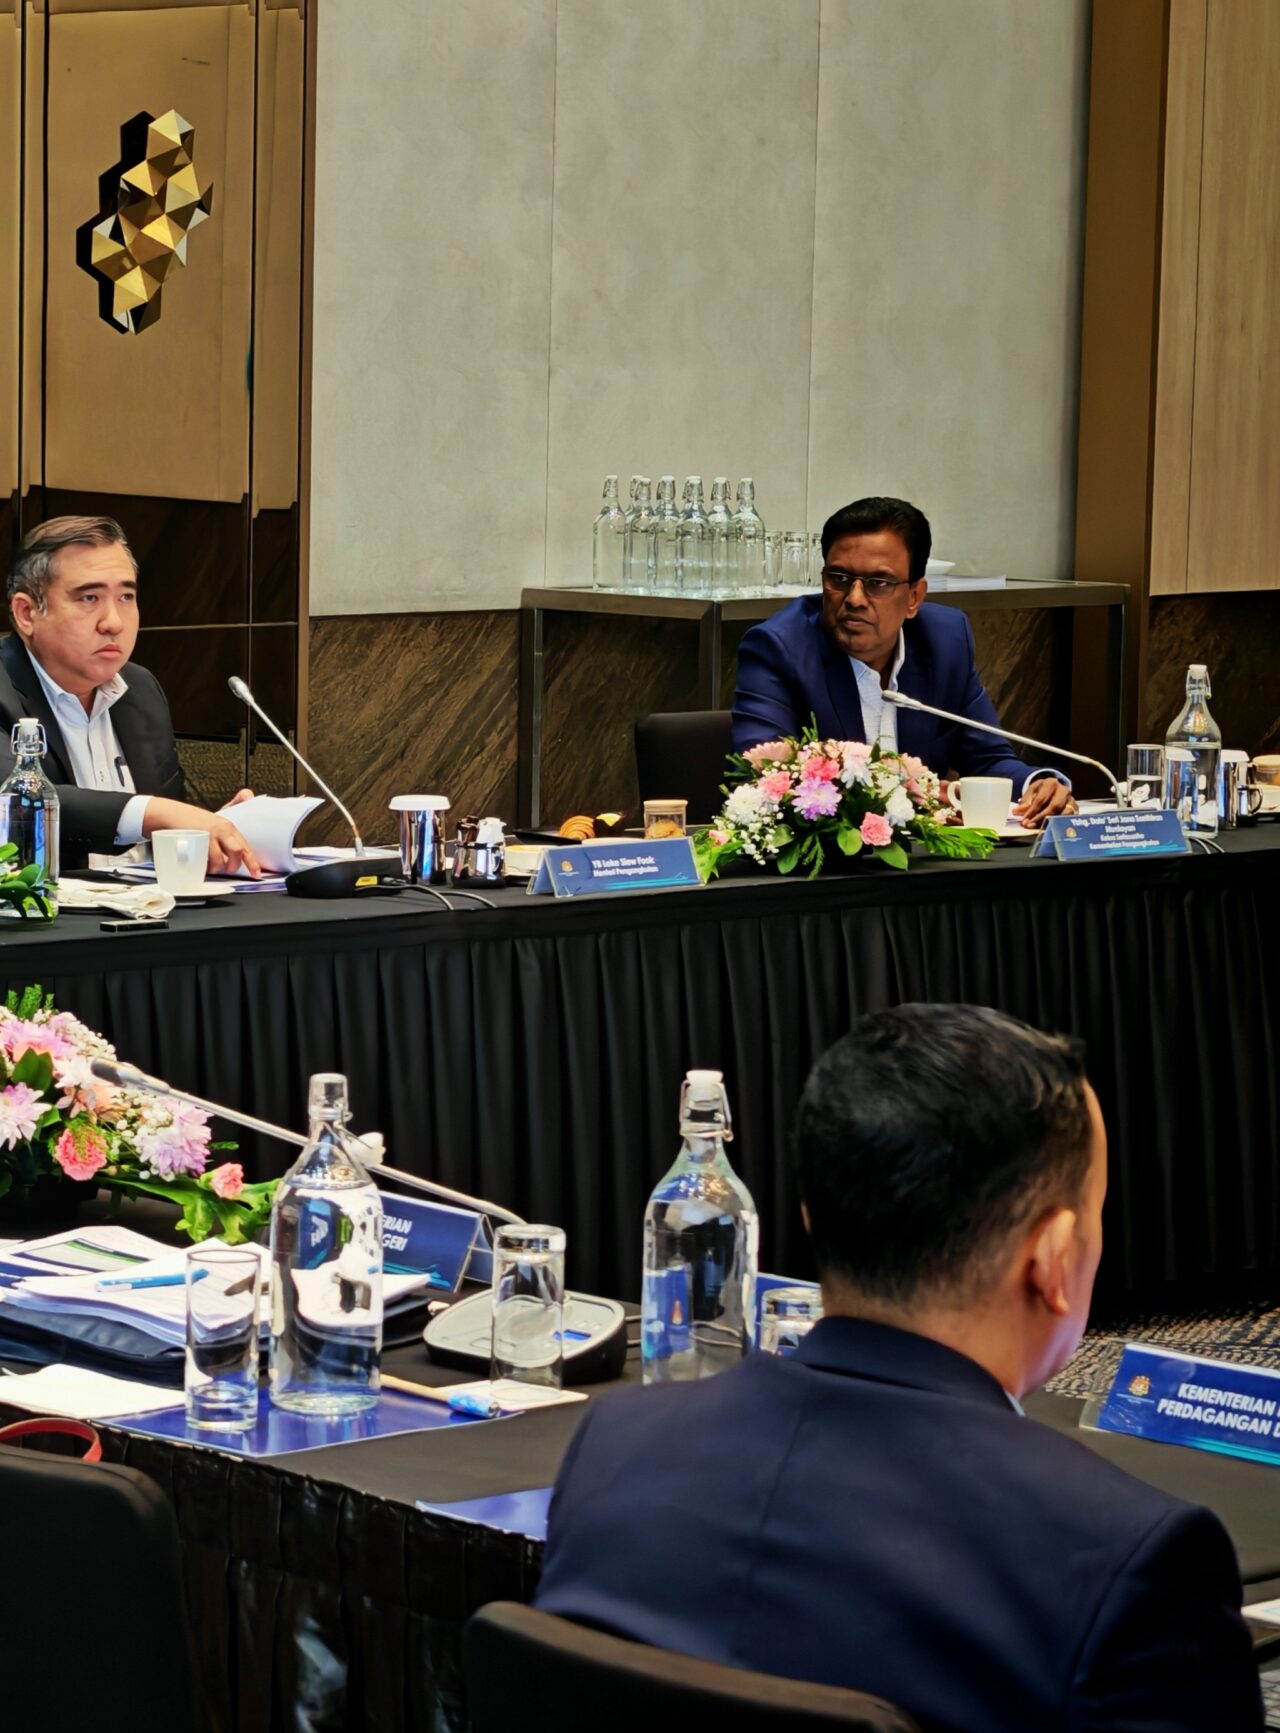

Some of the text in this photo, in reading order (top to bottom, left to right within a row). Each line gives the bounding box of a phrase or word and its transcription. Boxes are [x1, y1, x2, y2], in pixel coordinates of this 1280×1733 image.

[382, 1233, 409, 1251] GERI
[1157, 1398, 1273, 1436] PERDAGANGAN
[1177, 1383, 1277, 1417] KEMENTERIAN
